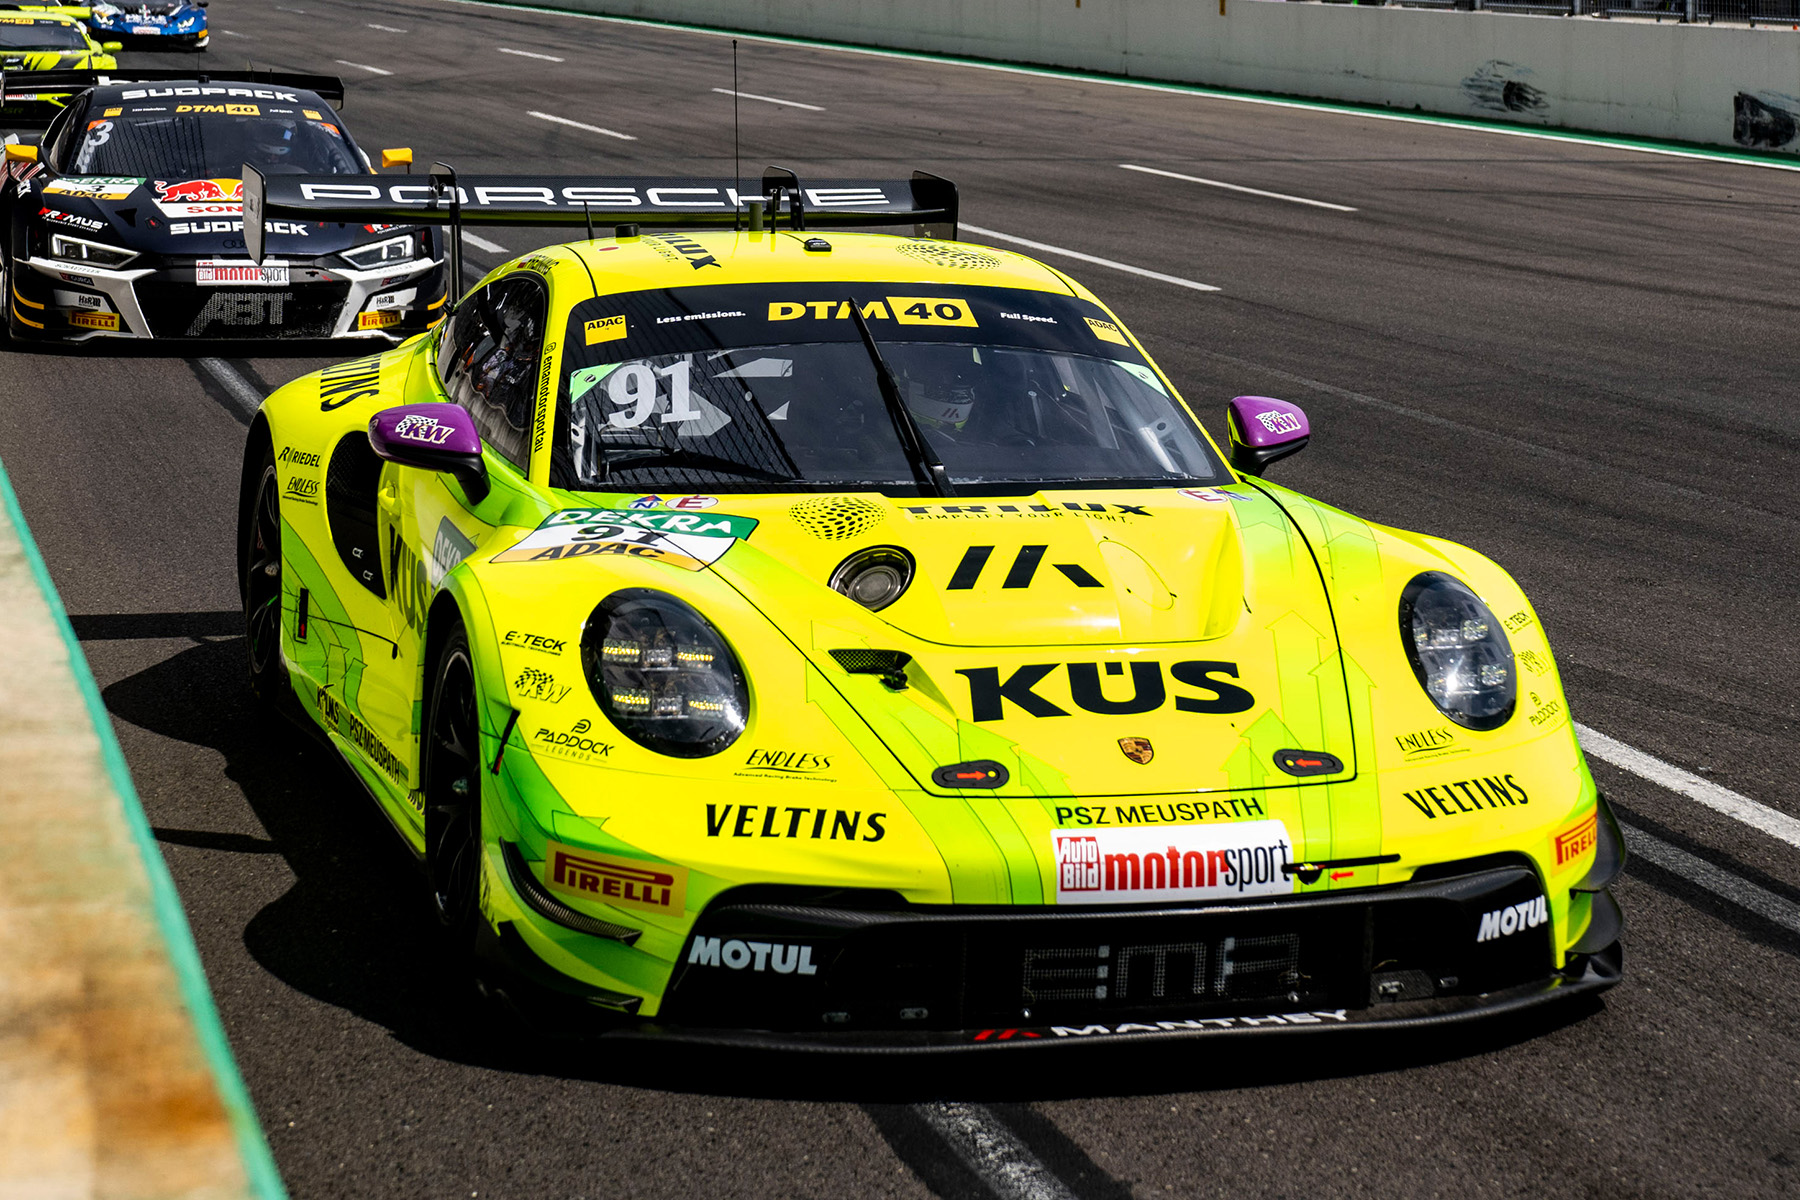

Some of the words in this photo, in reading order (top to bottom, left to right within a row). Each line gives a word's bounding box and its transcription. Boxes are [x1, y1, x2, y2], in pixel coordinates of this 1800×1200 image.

[176, 104, 226, 113] DTM
[231, 106, 255, 114] 40
[89, 121, 114, 146] 3
[58, 189, 112, 199] ADAC
[72, 311, 116, 328] PIRELLI
[185, 292, 293, 336] ABT
[362, 311, 398, 327] PIRELLI
[656, 316, 682, 325] Less
[684, 310, 747, 321] emissions.
[768, 301, 889, 321] DTM
[904, 302, 963, 320] 40
[1000, 311, 1021, 320] Full
[1022, 313, 1059, 325] Speed.
[587, 316, 624, 331] ADAC
[1087, 317, 1118, 333] ADAC
[608, 361, 701, 429] 91
[402, 421, 456, 444] KW
[293, 450, 320, 468] RIEDEL
[287, 476, 321, 494] ENDLESS
[897, 502, 1154, 518] TRILUX
[915, 513, 1011, 521] SIMPLIFY
[1017, 511, 1064, 520] YOUR
[1074, 511, 1133, 526] LIGHT.
[547, 510, 732, 534] DEKRA
[530, 542, 666, 561] ADAC
[955, 660, 1256, 723] KÜS
[534, 727, 616, 757] PADDOCK
[1395, 727, 1454, 752] ENDLESS
[545, 744, 592, 761] LEGENDS
[745, 748, 836, 770] ENDLESS
[1402, 774, 1529, 820] VELTINS
[706, 803, 887, 842] VELTINS
[1055, 805, 1111, 825] PSZ
[1115, 797, 1264, 824] MEUSPATH
[1059, 837, 1099, 862] Auto
[1555, 812, 1598, 866] PIRELL
[553, 850, 674, 907] PIRELLI
[1062, 863, 1100, 889] Bild
[1477, 894, 1549, 943] MOTUL
[688, 935, 817, 975] MOTUL
[1050, 1008, 1349, 1037] MANTHEY
